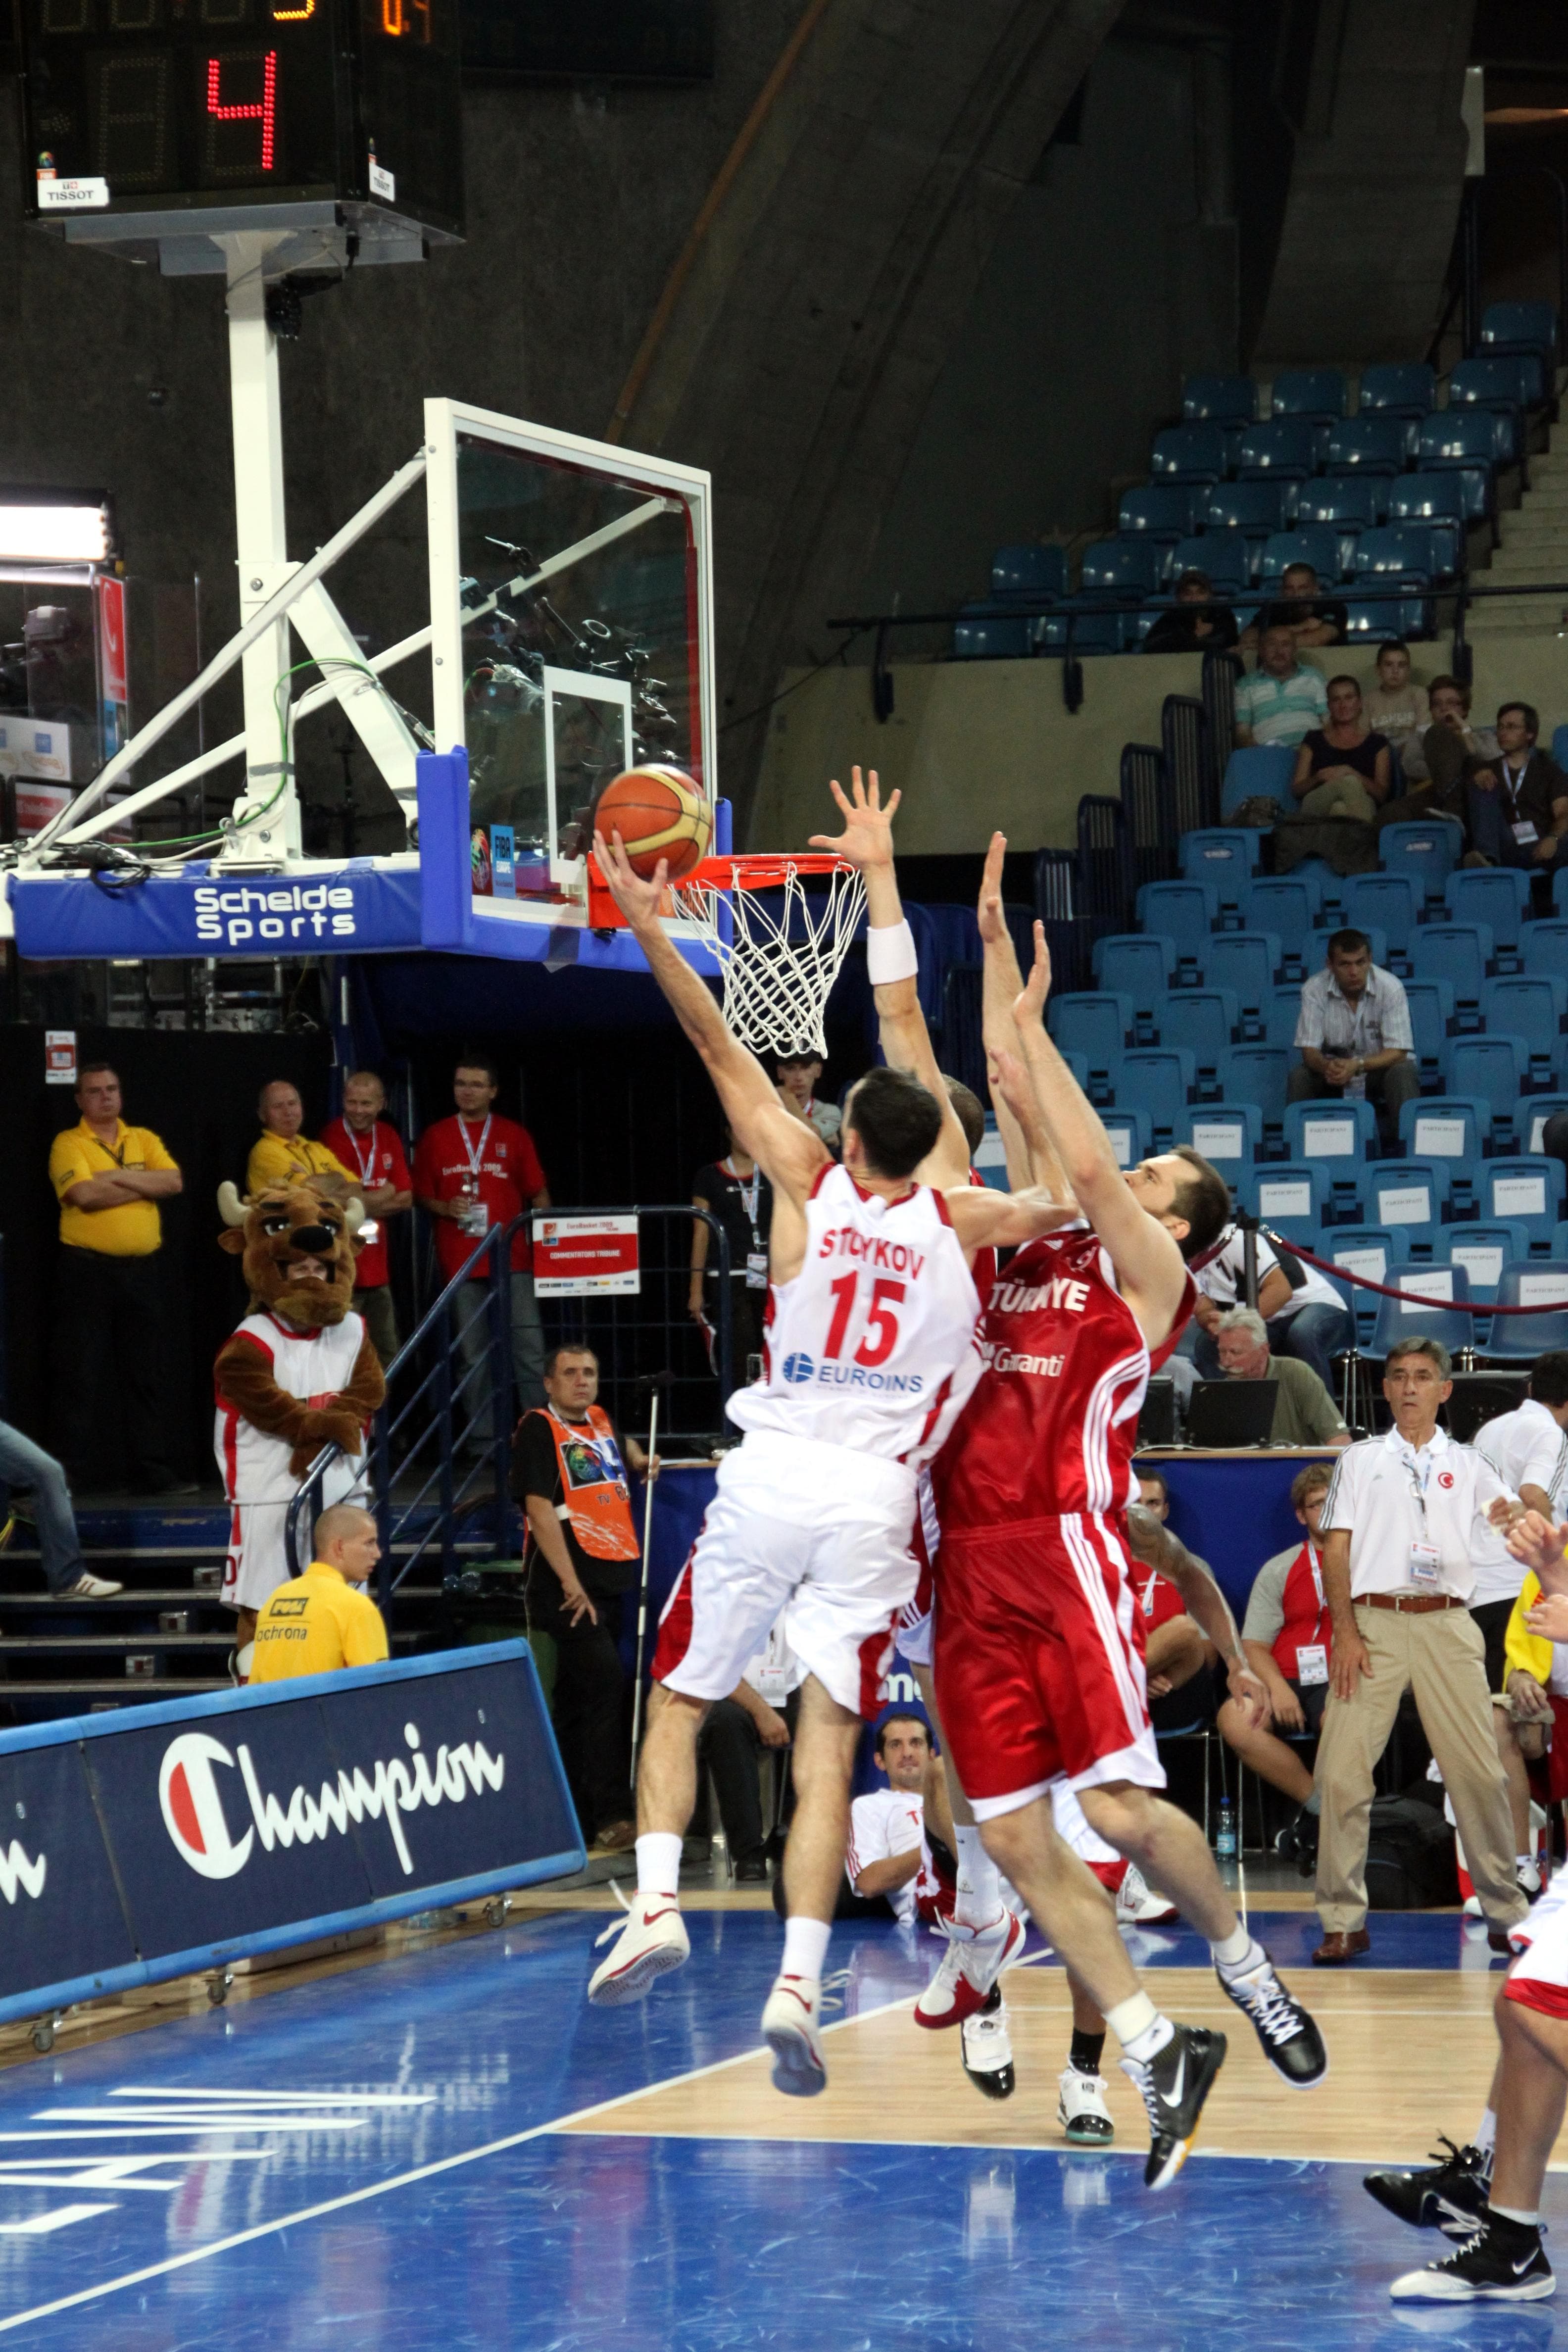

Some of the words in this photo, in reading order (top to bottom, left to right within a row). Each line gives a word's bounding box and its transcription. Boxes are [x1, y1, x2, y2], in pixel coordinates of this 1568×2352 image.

[207, 50, 277, 170] 4
[47, 190, 94, 201] TISSOT
[495, 835, 511, 859] FIBA
[194, 884, 354, 913] Schelde
[196, 911, 355, 946] Sports
[442, 1163, 482, 1176] EuroBast
[550, 1251, 595, 1260] COMMENTATORS
[819, 1226, 925, 1281] STOYKOV
[987, 1273, 1090, 1312] TÜRYE
[823, 1269, 907, 1368] 15
[993, 1346, 1065, 1377] Granti
[818, 1366, 924, 1393] EUROINS
[596, 1494, 610, 1505] TV
[256, 1625, 307, 1642] ochrona
[159, 1722, 504, 1879] Champion
